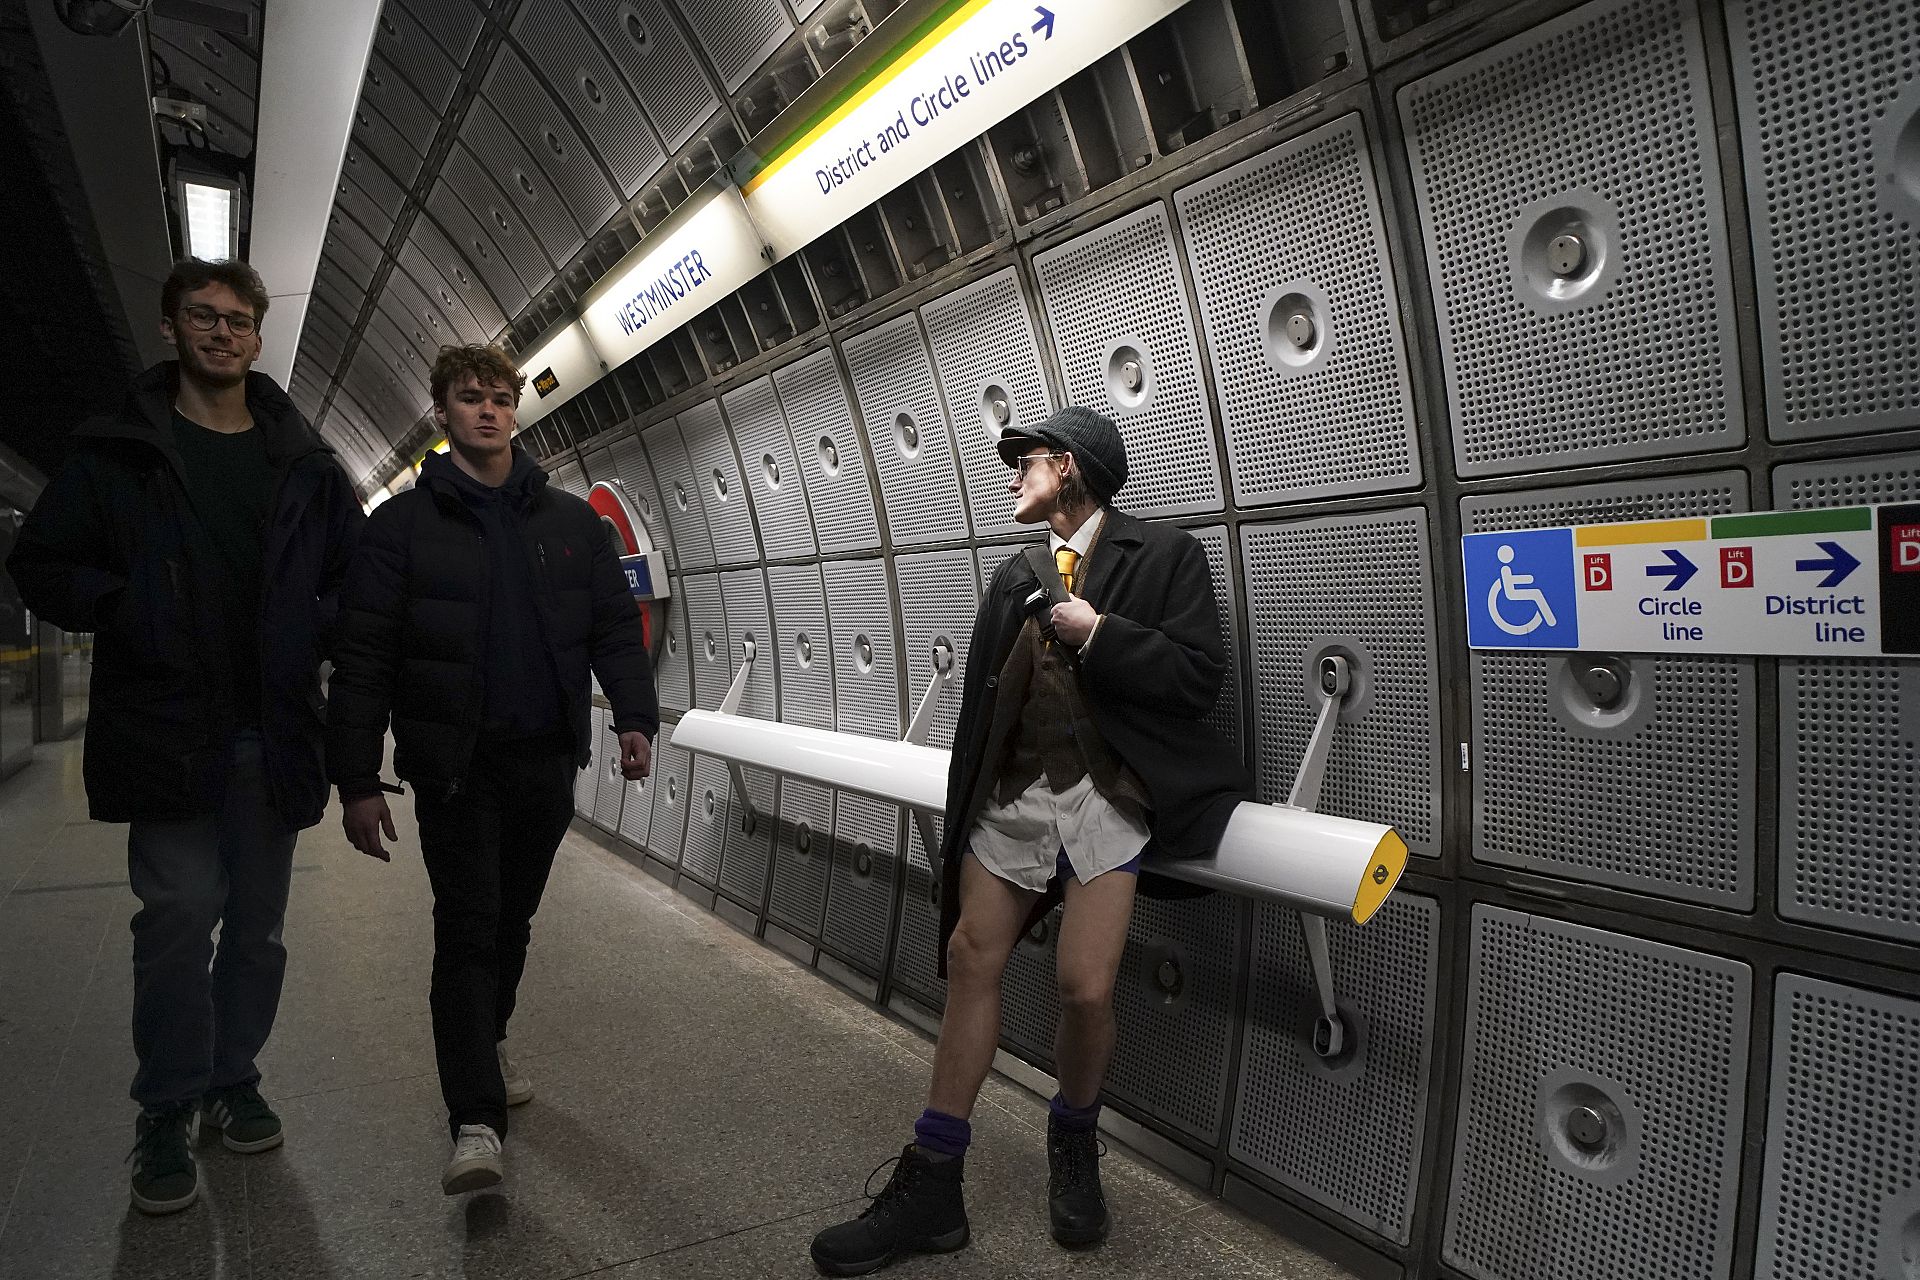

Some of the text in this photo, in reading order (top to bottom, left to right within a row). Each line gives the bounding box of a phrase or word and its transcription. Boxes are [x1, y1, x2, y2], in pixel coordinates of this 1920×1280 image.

[815, 31, 1028, 195] District and Circle lines
[615, 249, 712, 337] WESTMINSTER
[1590, 556, 1604, 566] Lift
[1727, 550, 1745, 559] Lift
[1900, 541, 1920, 566] D
[1589, 567, 1607, 587] D
[1726, 561, 1748, 583] D
[1638, 597, 1702, 616] Circle
[1765, 595, 1865, 615] District
[1663, 622, 1704, 641] line
[1815, 622, 1865, 643] line
